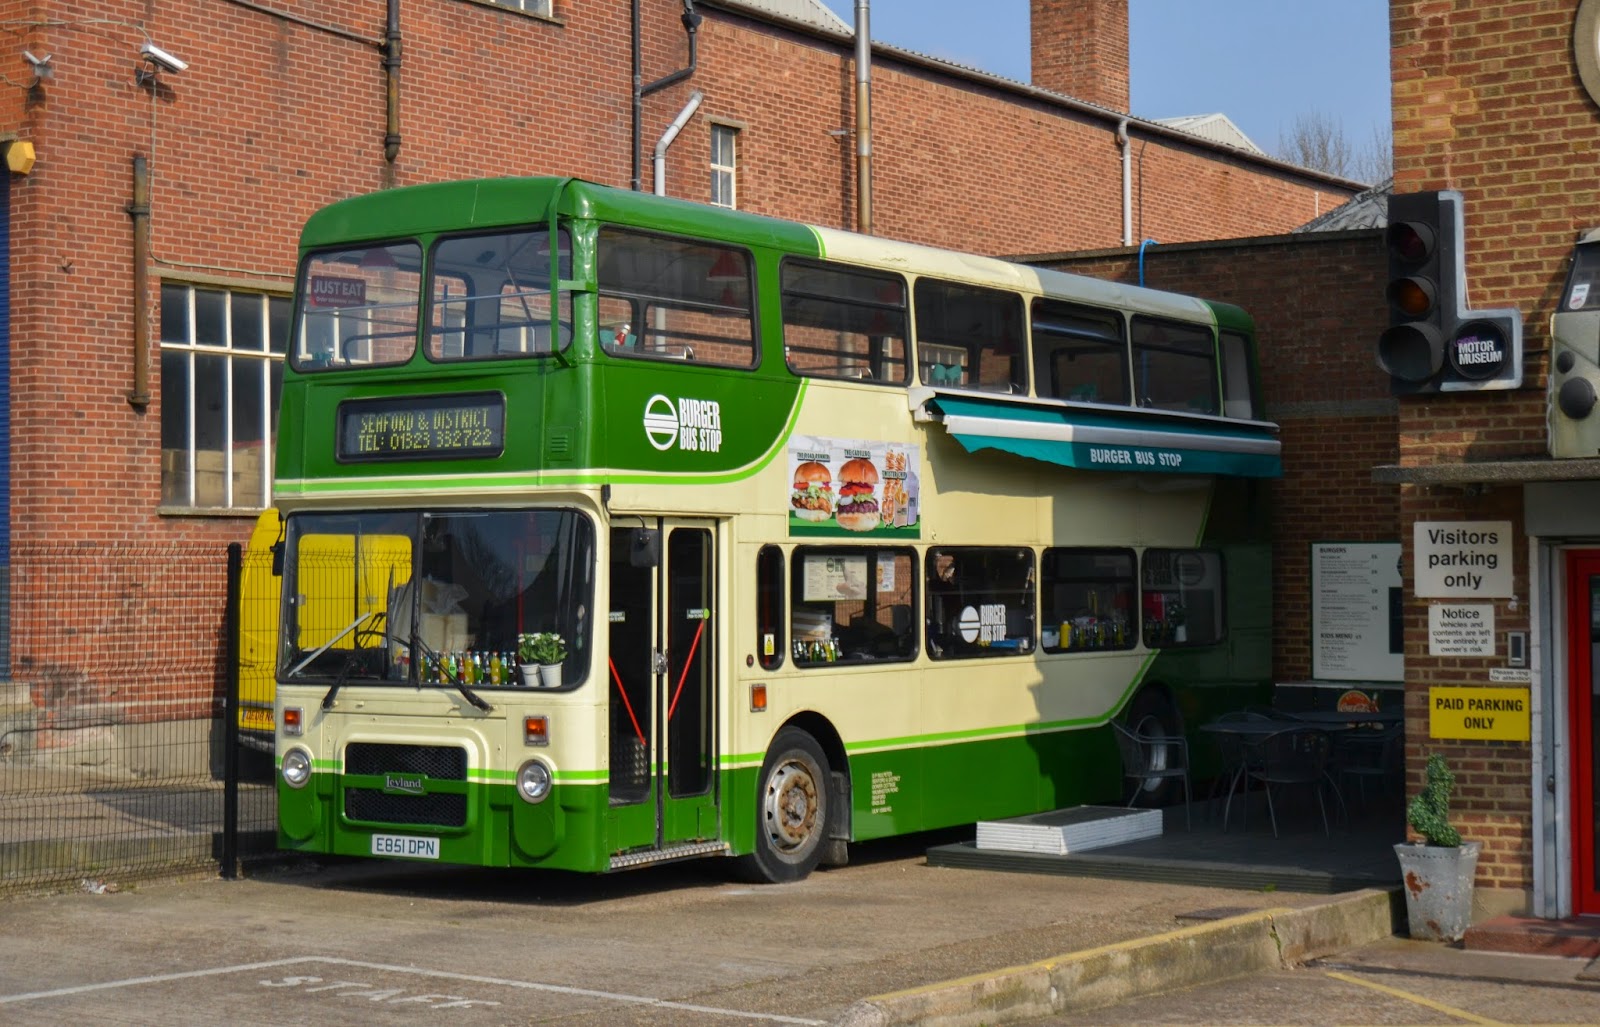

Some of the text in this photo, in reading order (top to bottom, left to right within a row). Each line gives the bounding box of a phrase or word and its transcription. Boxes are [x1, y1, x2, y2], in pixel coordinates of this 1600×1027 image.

[313, 280, 363, 296] JUST EAT
[1458, 340, 1494, 354] MOTOR
[1459, 351, 1502, 365] MUSEUM
[361, 407, 489, 433] SEAFORD & DISTRICT
[679, 397, 720, 429] BURGER
[359, 428, 492, 451] TEL: 01323 332722
[680, 427, 722, 452] BUS STOP
[1090, 448, 1182, 466] BURGER BUS STOP
[1428, 529, 1498, 544] Visitors
[1428, 550, 1498, 570] parking
[1444, 571, 1482, 590] only
[981, 604, 1006, 625] BURGER
[1442, 608, 1480, 619] Notice
[981, 625, 1006, 641] BUS STOP
[1436, 698, 1523, 711] PAID PARKING
[1464, 717, 1494, 729] ONLY
[386, 775, 422, 789] Leyland
[376, 838, 435, 856] E851 DPN
